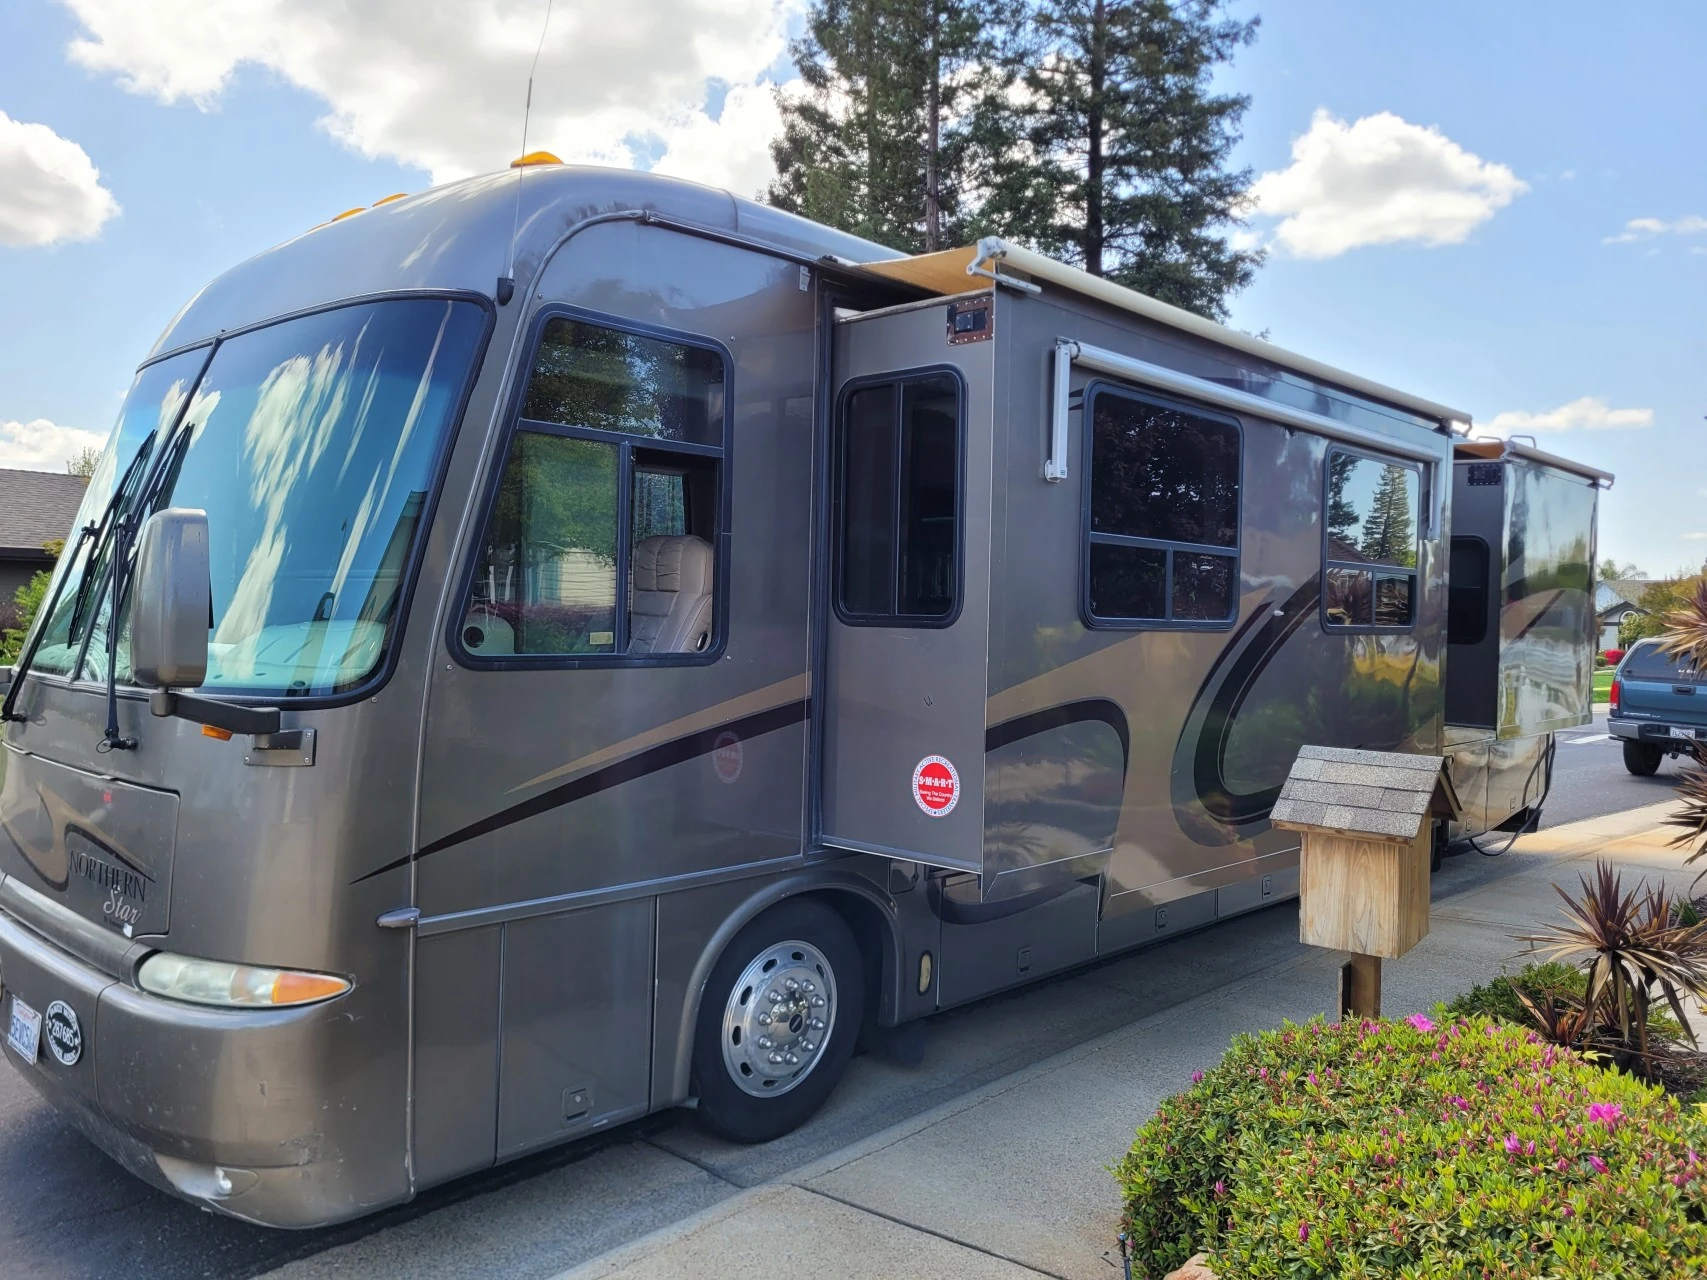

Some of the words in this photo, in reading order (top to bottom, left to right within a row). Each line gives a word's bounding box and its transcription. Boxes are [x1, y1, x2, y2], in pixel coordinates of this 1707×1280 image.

[70, 850, 146, 903] NORTHERN
[103, 889, 142, 924] Star
[52, 1018, 75, 1047] 287685
